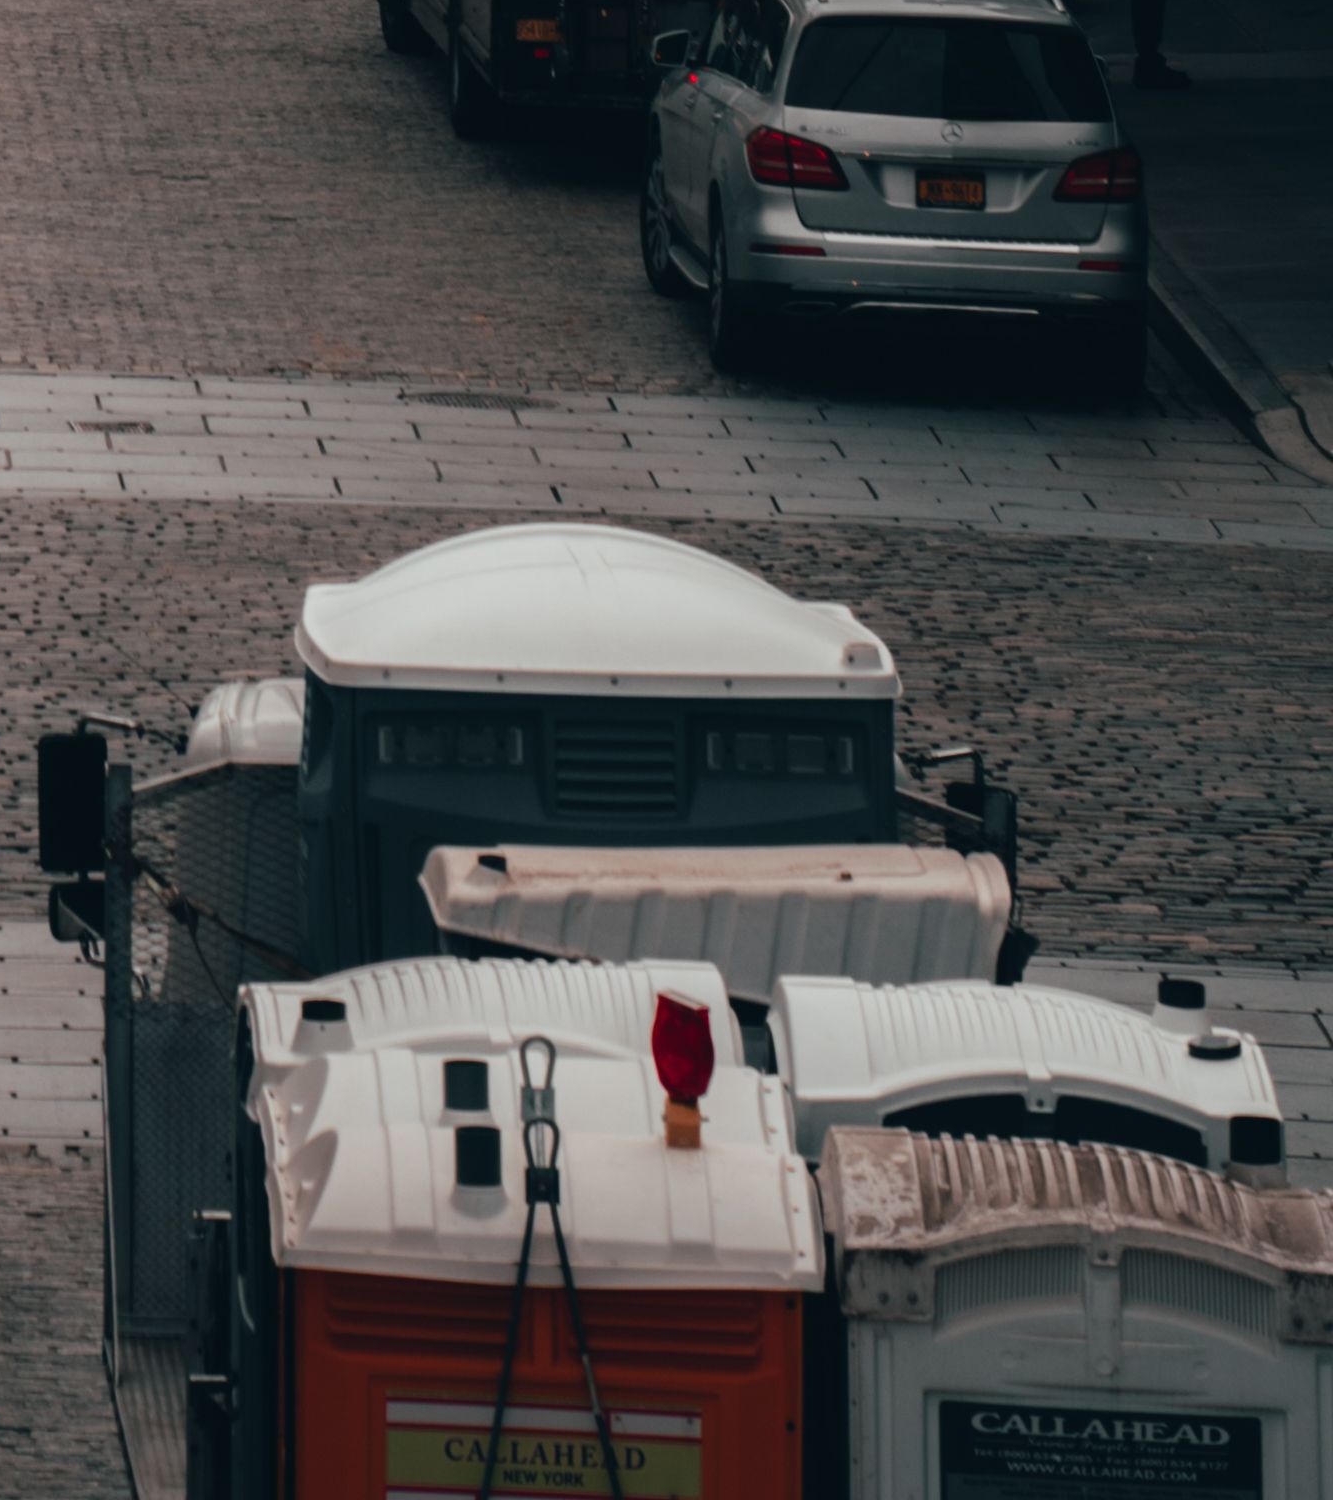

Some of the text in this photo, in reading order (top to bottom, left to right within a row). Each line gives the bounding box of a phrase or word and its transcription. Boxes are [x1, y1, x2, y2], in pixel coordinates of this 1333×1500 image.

[971, 1411, 1231, 1445] CALLAHEAD
[503, 1469, 584, 1488] NEW YORK
[1006, 1460, 1198, 1483] WWW.CALLAHEAD.COM
